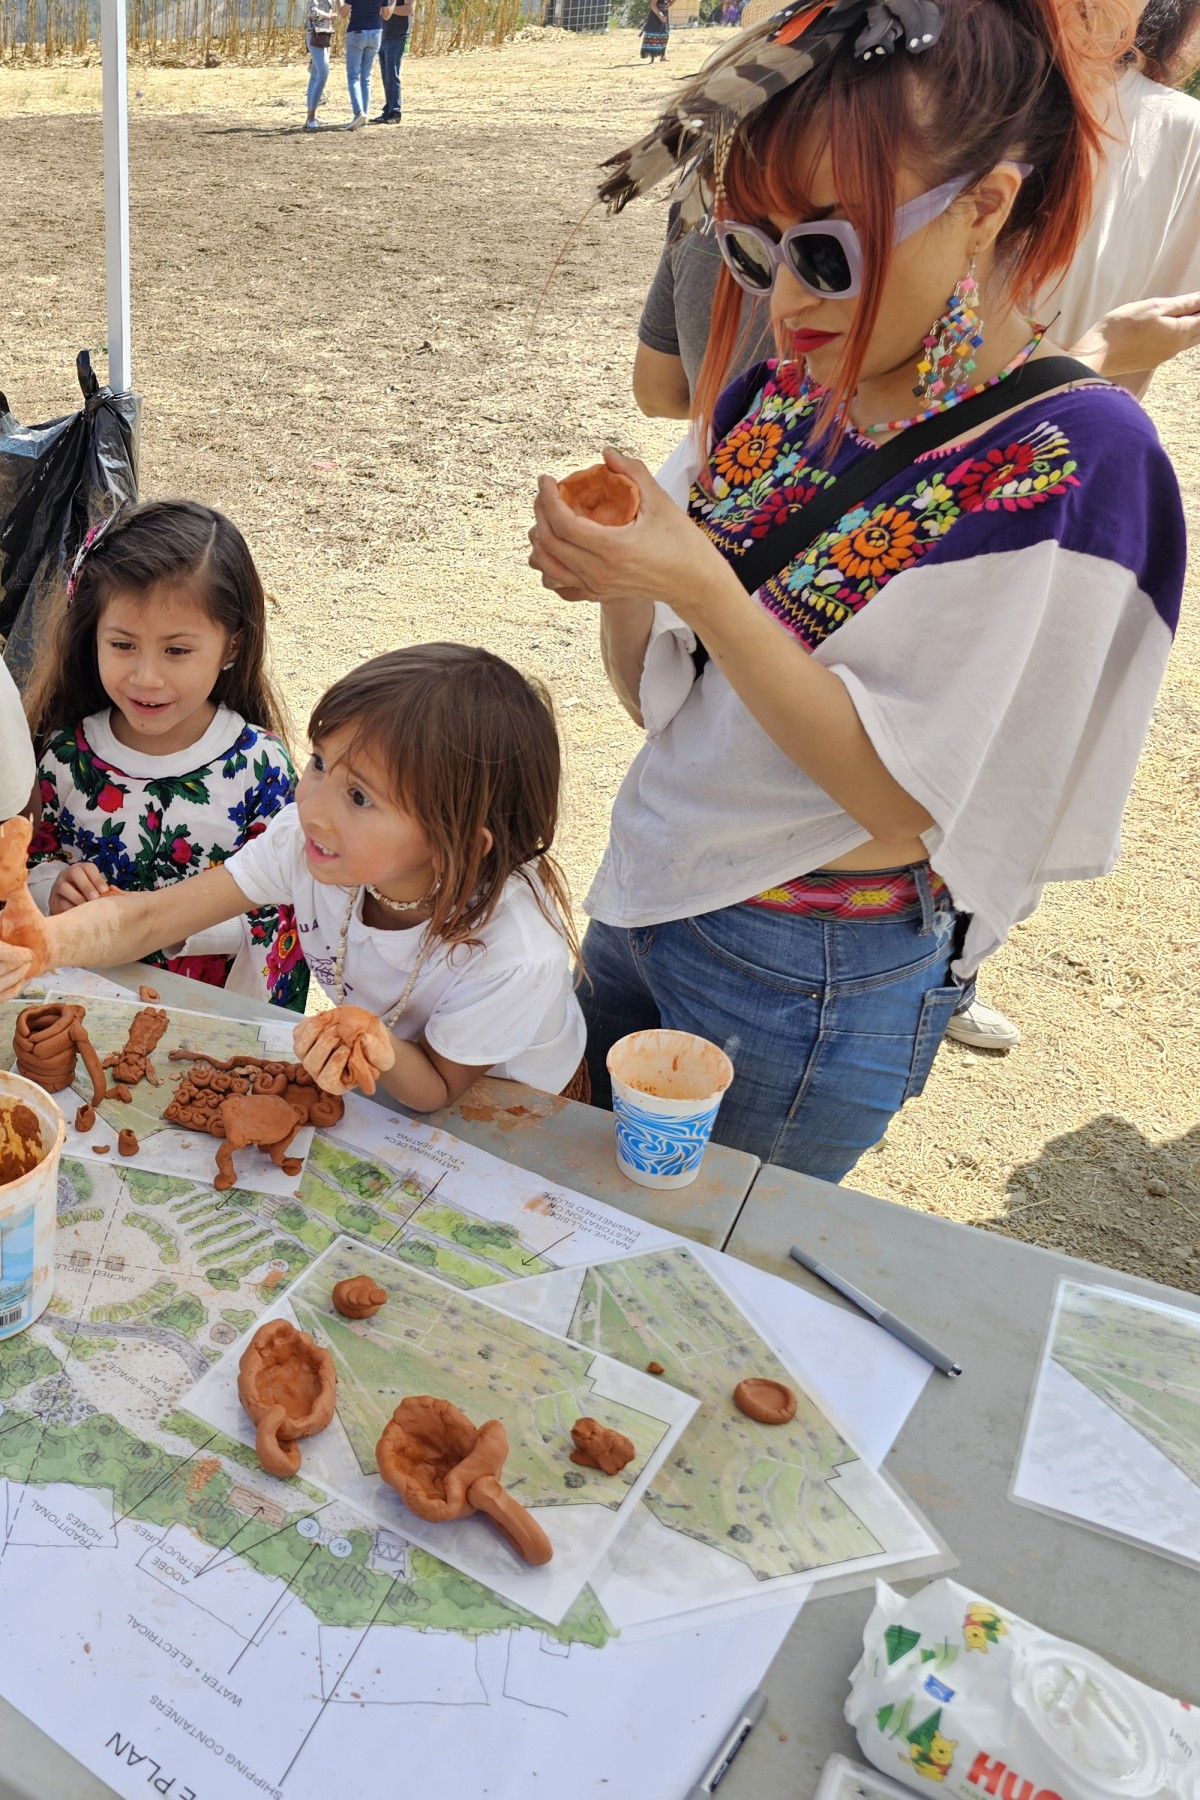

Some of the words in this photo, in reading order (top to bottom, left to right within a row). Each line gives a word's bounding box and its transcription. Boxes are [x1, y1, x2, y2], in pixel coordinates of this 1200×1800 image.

[383, 1134, 408, 1149] DECK
[396, 1133, 435, 1151] SEATING
[408, 1145, 460, 1172] GATHERING
[435, 1150, 459, 1163] PLAY
[542, 1192, 575, 1208] SLOPE
[547, 1202, 564, 1212] ON
[548, 1210, 592, 1234] HILLSIDE
[566, 1209, 636, 1244] RESTORATION
[576, 1206, 641, 1238] ENGINEERED
[593, 1231, 631, 1250] NATIVE
[54, 1262, 91, 1275] CIRCLE
[93, 1269, 135, 1283] SACRED
[137, 1383, 164, 1403] FLEX
[147, 1374, 173, 1393] PLAY
[30, 1499, 94, 1550] TRADITIONAL
[65, 1512, 104, 1541] HOMES
[132, 1524, 201, 1574] STRUCTURES
[150, 1556, 190, 1585] ADOBE
[127, 1613, 194, 1669] ELECTRICAL
[201, 1671, 243, 1708] WATER
[149, 1694, 225, 1756] CONTAINERS
[104, 1731, 176, 1795] PLAN
[224, 1752, 284, 1800] SHIPPING
